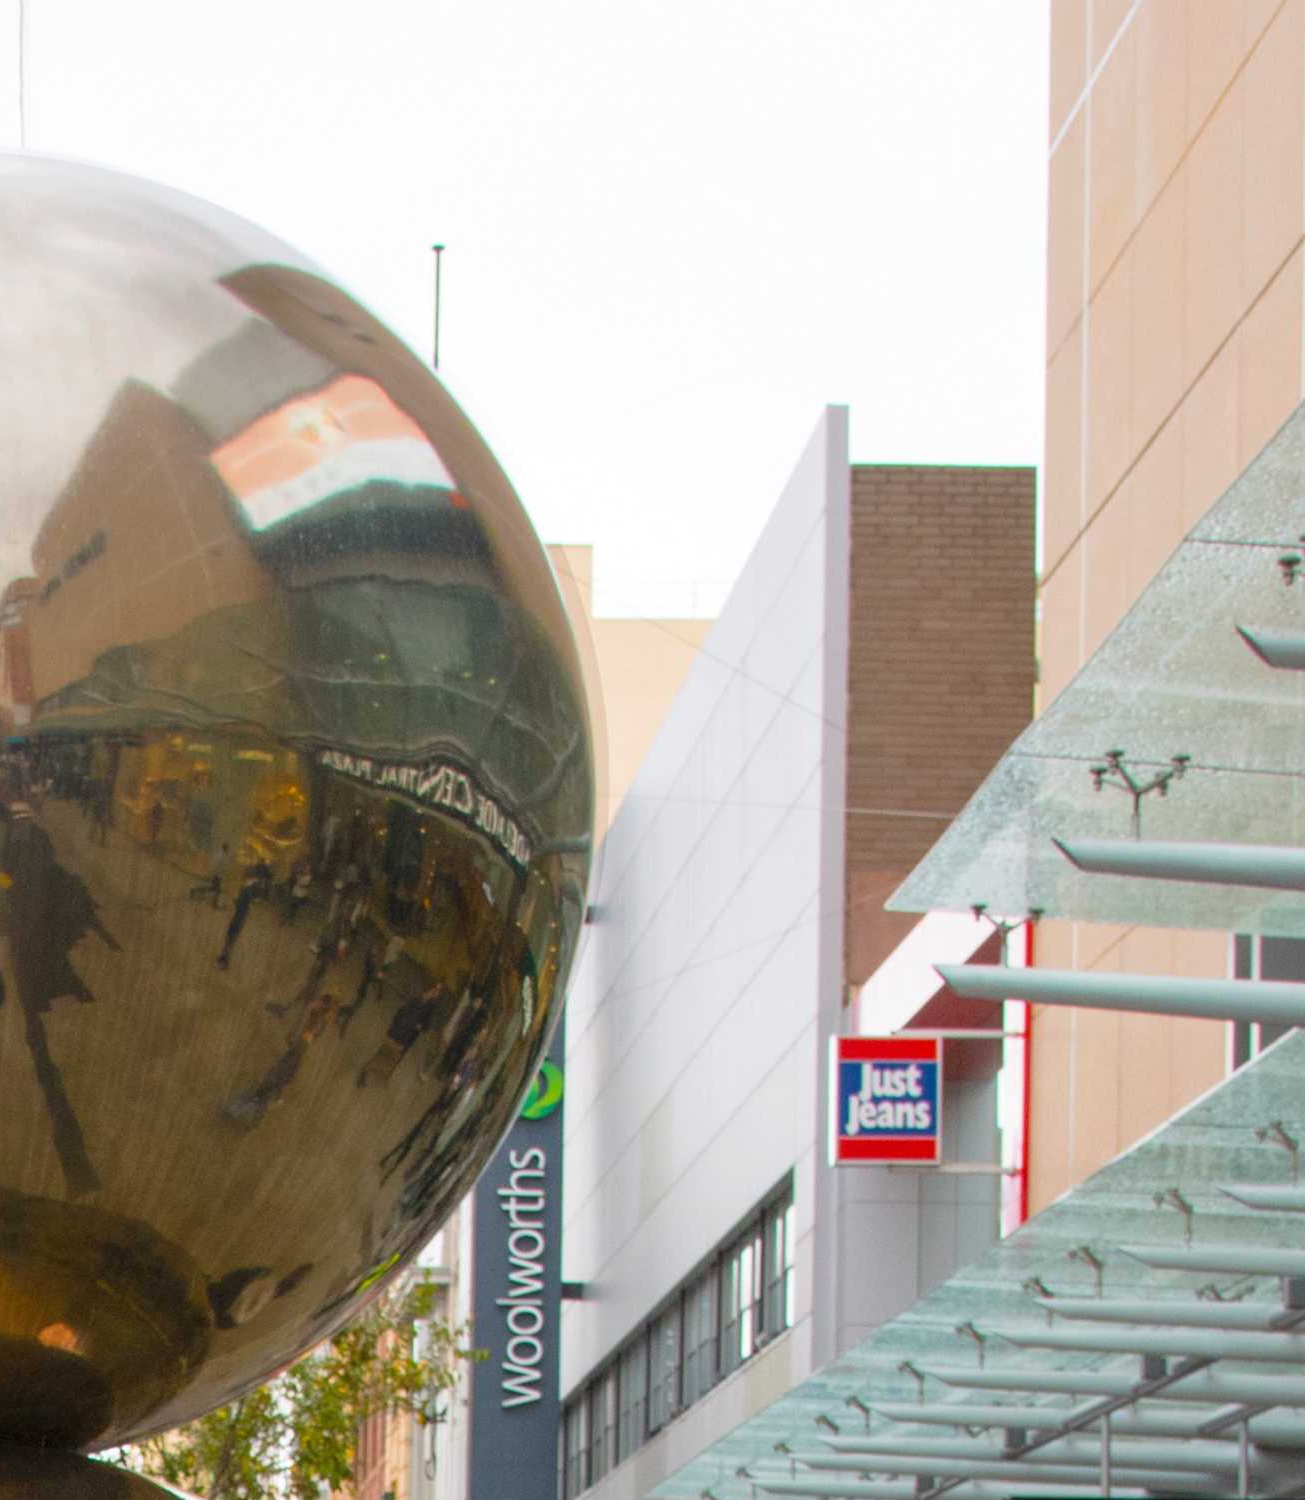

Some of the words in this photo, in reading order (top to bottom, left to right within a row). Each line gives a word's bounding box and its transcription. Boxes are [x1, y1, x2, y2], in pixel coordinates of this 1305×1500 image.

[859, 1063, 923, 1101] Just
[846, 1094, 932, 1136] Jeans
[496, 1148, 546, 1409] Woolworths
